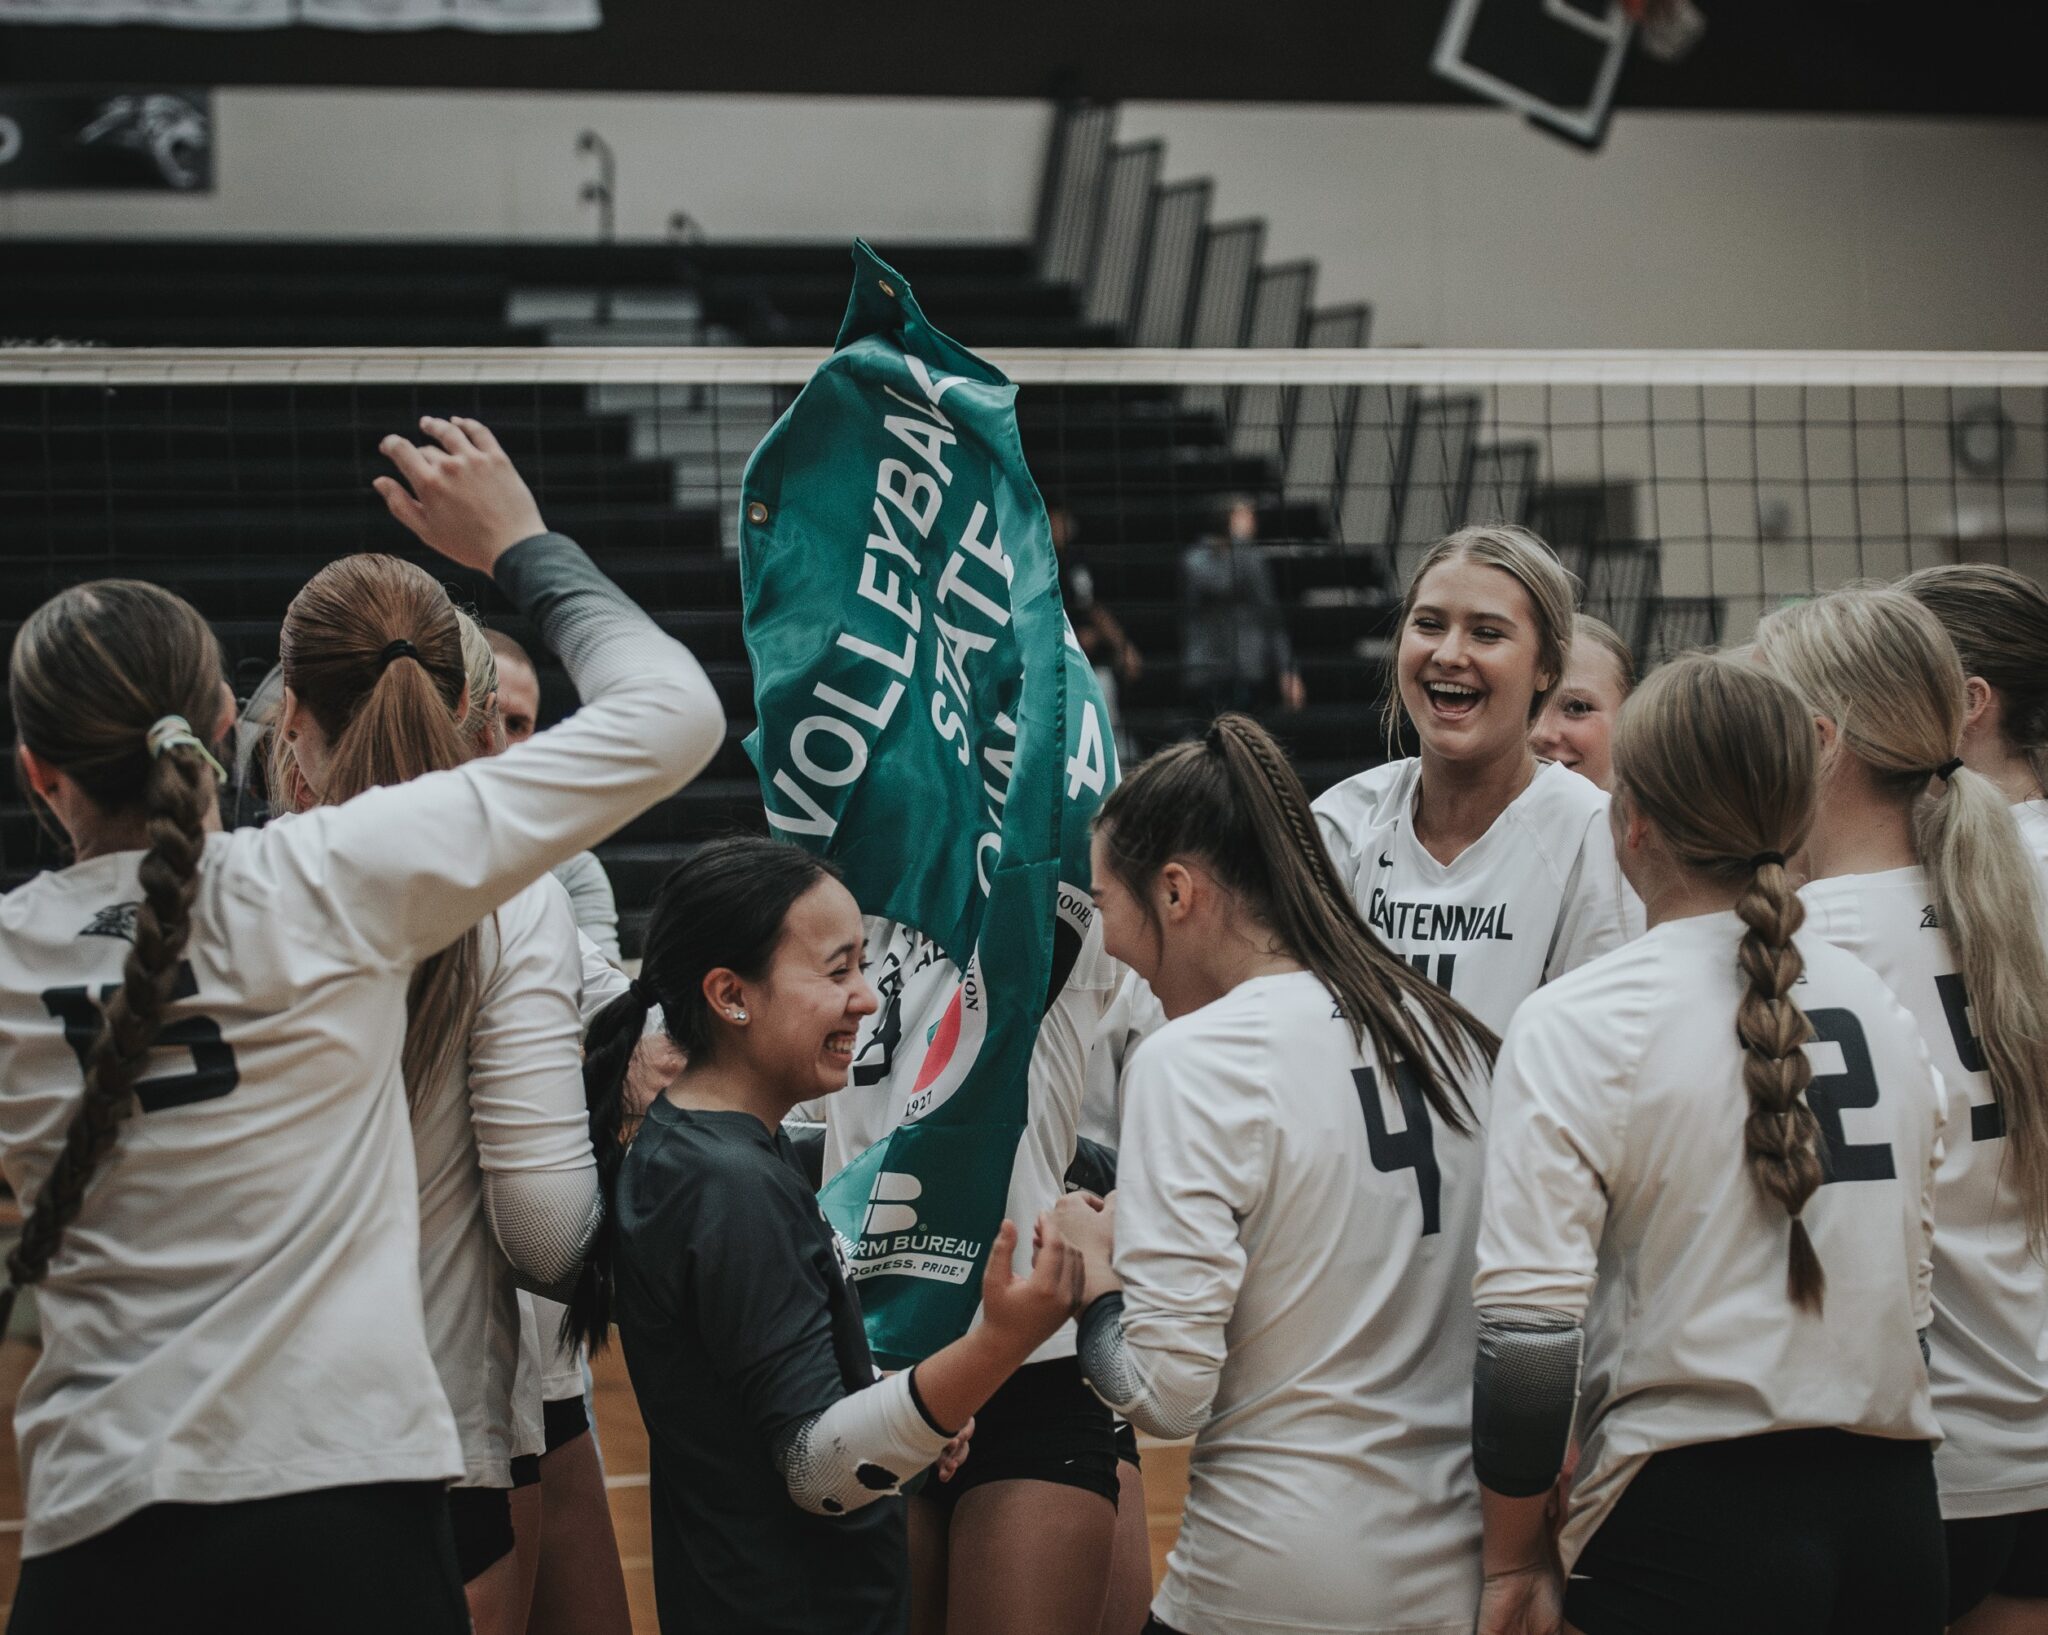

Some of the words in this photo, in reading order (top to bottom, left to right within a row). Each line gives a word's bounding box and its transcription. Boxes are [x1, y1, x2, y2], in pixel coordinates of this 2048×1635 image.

[931, 500, 1014, 766] STATE
[1057, 891, 1092, 930] CHOO
[1368, 887, 1513, 941] CNTENNIAL
[905, 1090, 933, 1117] 1927
[1351, 1055, 1441, 1237] 4
[893, 1235, 981, 1259] BUREAU
[850, 1259, 917, 1277] OGRESS.
